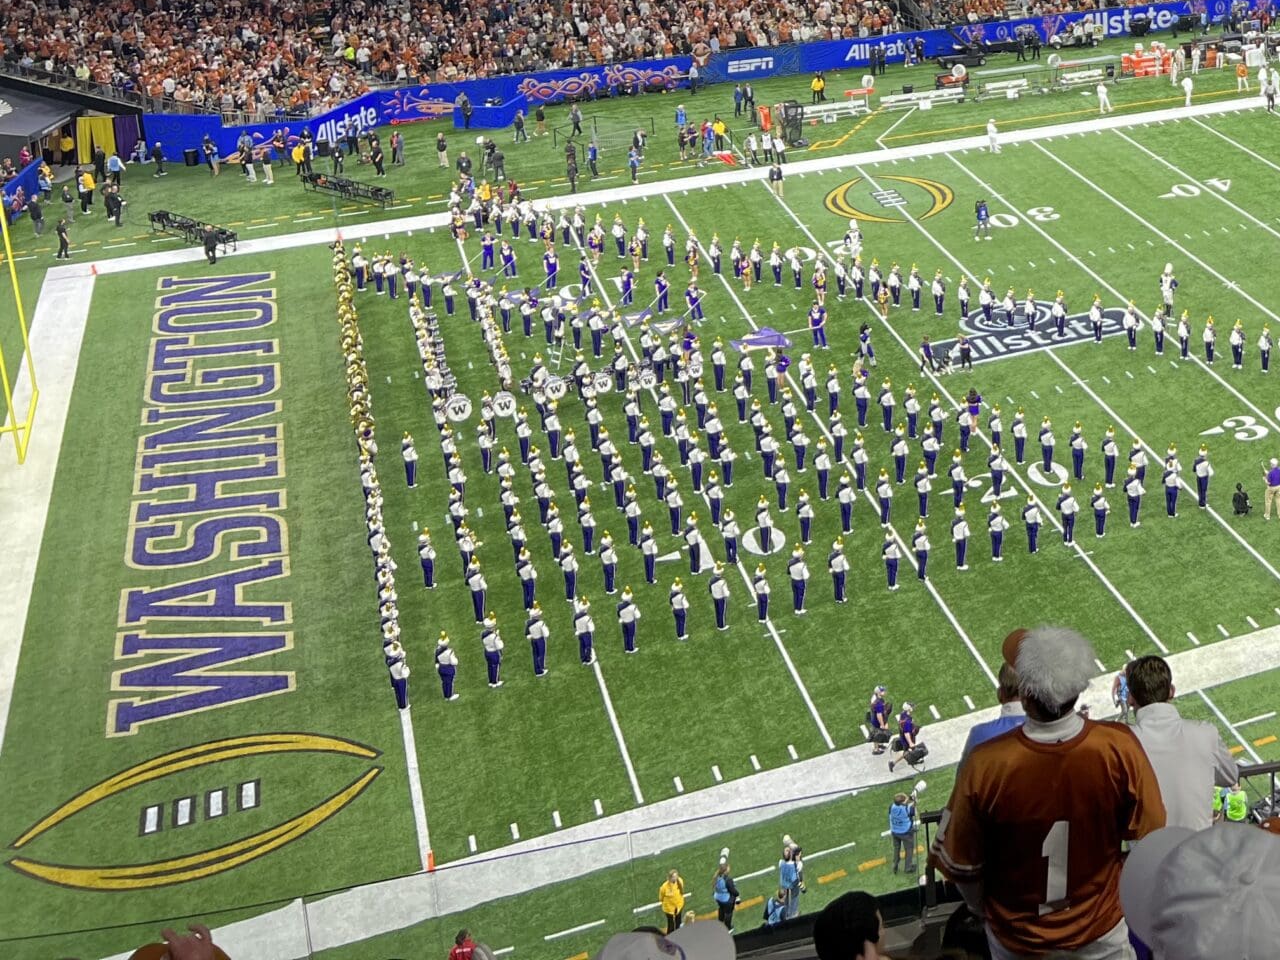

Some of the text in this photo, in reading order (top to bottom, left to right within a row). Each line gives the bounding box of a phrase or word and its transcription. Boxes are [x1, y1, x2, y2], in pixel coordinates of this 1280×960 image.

[727, 56, 774, 74] ESPN
[1171, 177, 1232, 198] 40
[988, 205, 1060, 228] 30
[549, 381, 564, 393] W
[597, 379, 609, 390] W
[451, 402, 468, 416] W
[496, 400, 512, 412] W
[105, 270, 297, 739] WASHINGTON
[1038, 820, 1071, 917] 1
